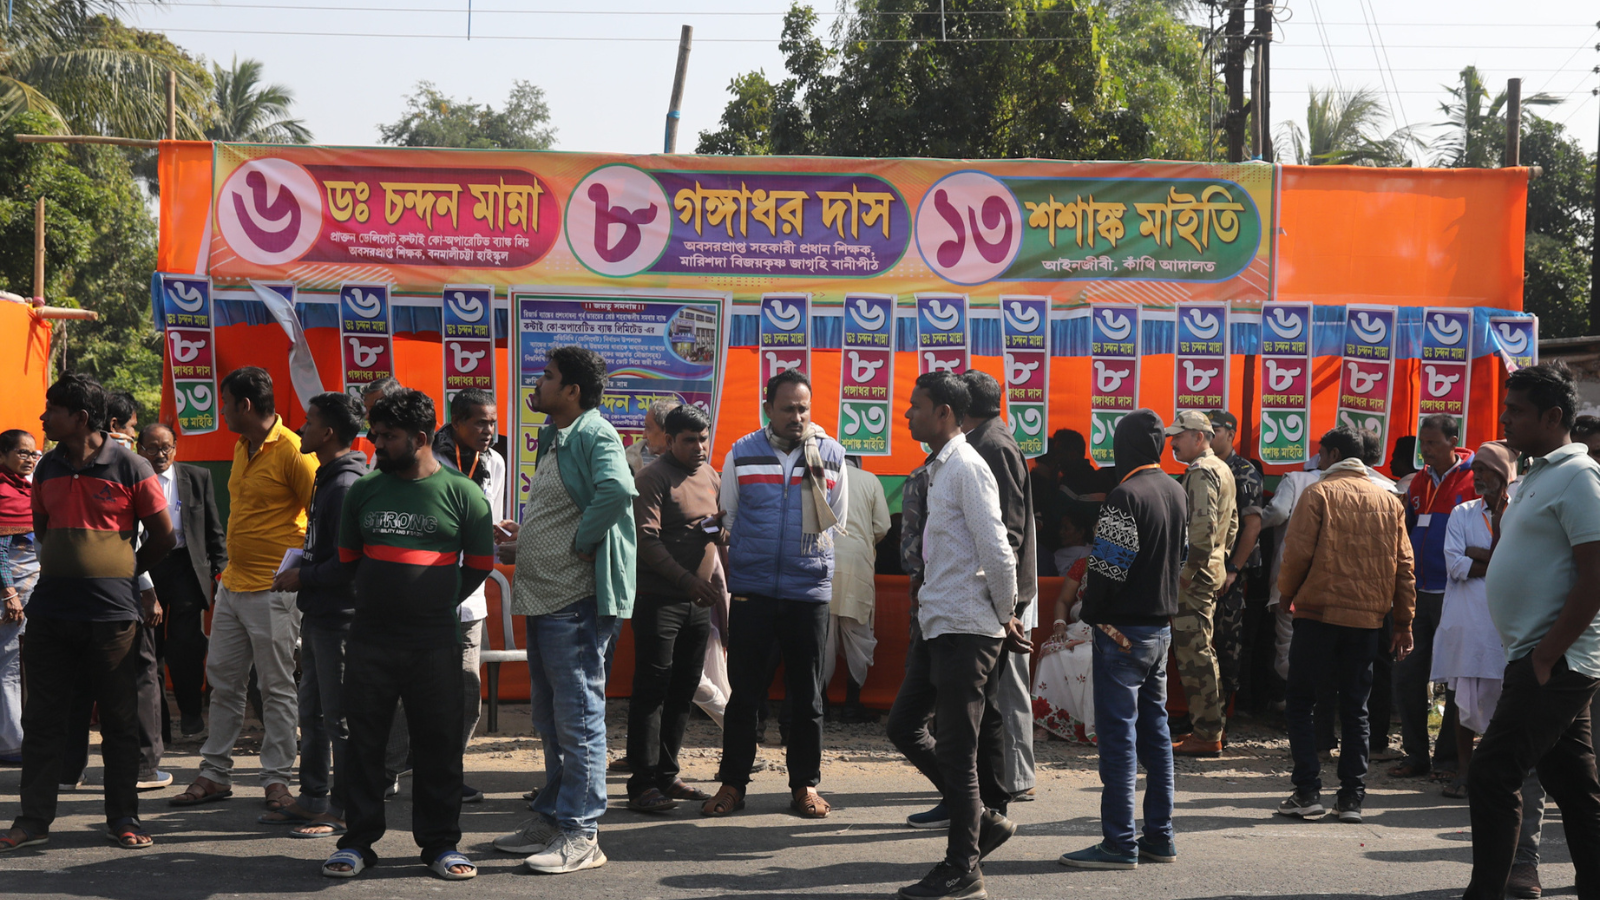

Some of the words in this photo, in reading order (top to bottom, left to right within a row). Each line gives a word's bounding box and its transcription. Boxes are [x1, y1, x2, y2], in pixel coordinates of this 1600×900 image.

[231, 170, 302, 253] ৬
[323, 180, 370, 223] ডঃ
[379, 182, 464, 230] চন্দন
[468, 176, 545, 233] মান্না
[673, 180, 810, 238] গঙ্গাধর
[815, 182, 895, 240] দাস
[587, 182, 658, 263] ৮
[933, 188, 1013, 269] ১৩
[1023, 194, 1128, 248] শশাঙ্ক
[1133, 185, 1245, 254] মাইতি
[330, 231, 356, 243] প্রাক্তন
[428, 233, 490, 246] কো-অপারেটিভ
[492, 236, 512, 248] ব্যাঙ্ক
[683, 241, 747, 254] অবসরপ্রাপ্ত
[749, 240, 797, 255] সহকারী
[800, 242, 831, 255] প্রধান
[833, 241, 875, 257] শিক্ষক,
[348, 246, 394, 259] অবসরপ্রাপ্ত
[395, 245, 425, 260] শিক্ষক,
[427, 246, 474, 261] বনমালীচট্টা
[476, 248, 509, 265] হাইস্কুল
[679, 253, 727, 268] মারিশদা
[730, 254, 786, 272] বিজয়কৃষ্ণ
[789, 256, 829, 273] জাগৃহি
[830, 255, 879, 271] বানীপীঠ
[1041, 254, 1119, 273] আইনজীবী,
[1122, 254, 1156, 272] কাঁথি
[1159, 257, 1217, 273] আদালত
[167, 281, 203, 313] ৬
[344, 288, 381, 318] ৬
[447, 291, 484, 322] ৬
[177, 314, 193, 325] চন্দন
[355, 320, 370, 331] চন্দন
[764, 299, 801, 331] ৬
[849, 299, 885, 331] ৬
[922, 299, 959, 331] ৬
[1004, 301, 1040, 333] ৬
[1095, 309, 1131, 341] ৬
[1182, 308, 1219, 340] ৬
[1266, 307, 1303, 340] ৬
[457, 324, 473, 336] চন্দন
[523, 320, 545, 333] কন্টাই
[546, 321, 595, 333] কো-অপারেটিভ
[597, 324, 613, 334] ব্যাঙ্ক
[614, 322, 643, 334] লিমিটেড
[1351, 311, 1387, 344] ৬
[1427, 313, 1463, 346] ৬
[170, 331, 206, 362] ৮
[773, 333, 789, 344] চন্দন
[857, 333, 873, 345] চন্দন
[931, 333, 948, 344] চন্দন
[1012, 335, 1028, 347] চন্দন
[1102, 342, 1118, 354] চন্দন
[1191, 341, 1207, 354] চন্দন
[1274, 341, 1290, 353] চন্দন
[1495, 323, 1528, 354] ৬
[348, 337, 384, 367] ৮
[449, 342, 486, 373] ৮
[1357, 344, 1373, 357] চন্দন
[1434, 347, 1450, 359] চন্দন
[195, 365, 211, 376] দাস
[348, 369, 373, 380] গঙ্গাধর
[848, 350, 884, 383] ৮
[1006, 353, 1039, 385] ৮
[1094, 361, 1130, 393] ৮
[1182, 360, 1219, 392] ৮
[1265, 359, 1302, 391] ৮
[447, 375, 474, 387] গঙ্গাধর
[476, 375, 490, 387] দাস
[1347, 362, 1383, 394] ৮
[1424, 365, 1460, 398] ৮
[844, 385, 870, 397] গঙ্গাধর
[871, 385, 887, 398] দাস
[1027, 387, 1042, 399] দাস
[1117, 395, 1132, 407] দাস
[1178, 394, 1204, 406] গঙ্গাধর
[1206, 394, 1222, 406] দাস
[1262, 393, 1288, 405] গঙ্গাধর
[1289, 393, 1304, 405] দাস
[1342, 394, 1368, 407] গঙ্গাধর
[1369, 396, 1384, 409] দাস
[1421, 399, 1446, 411] গঙ্গাধর
[1447, 399, 1462, 412] দাস
[190, 413, 213, 428] মাইতি
[843, 403, 886, 435] ১৩
[1262, 411, 1304, 444] ১৩
[841, 437, 861, 450] শশাঙ্ক
[863, 436, 885, 451] মাইতি
[1020, 438, 1043, 453] মাইতি
[1281, 444, 1304, 459] মাইতি
[364, 511, 438, 534] STRONG
